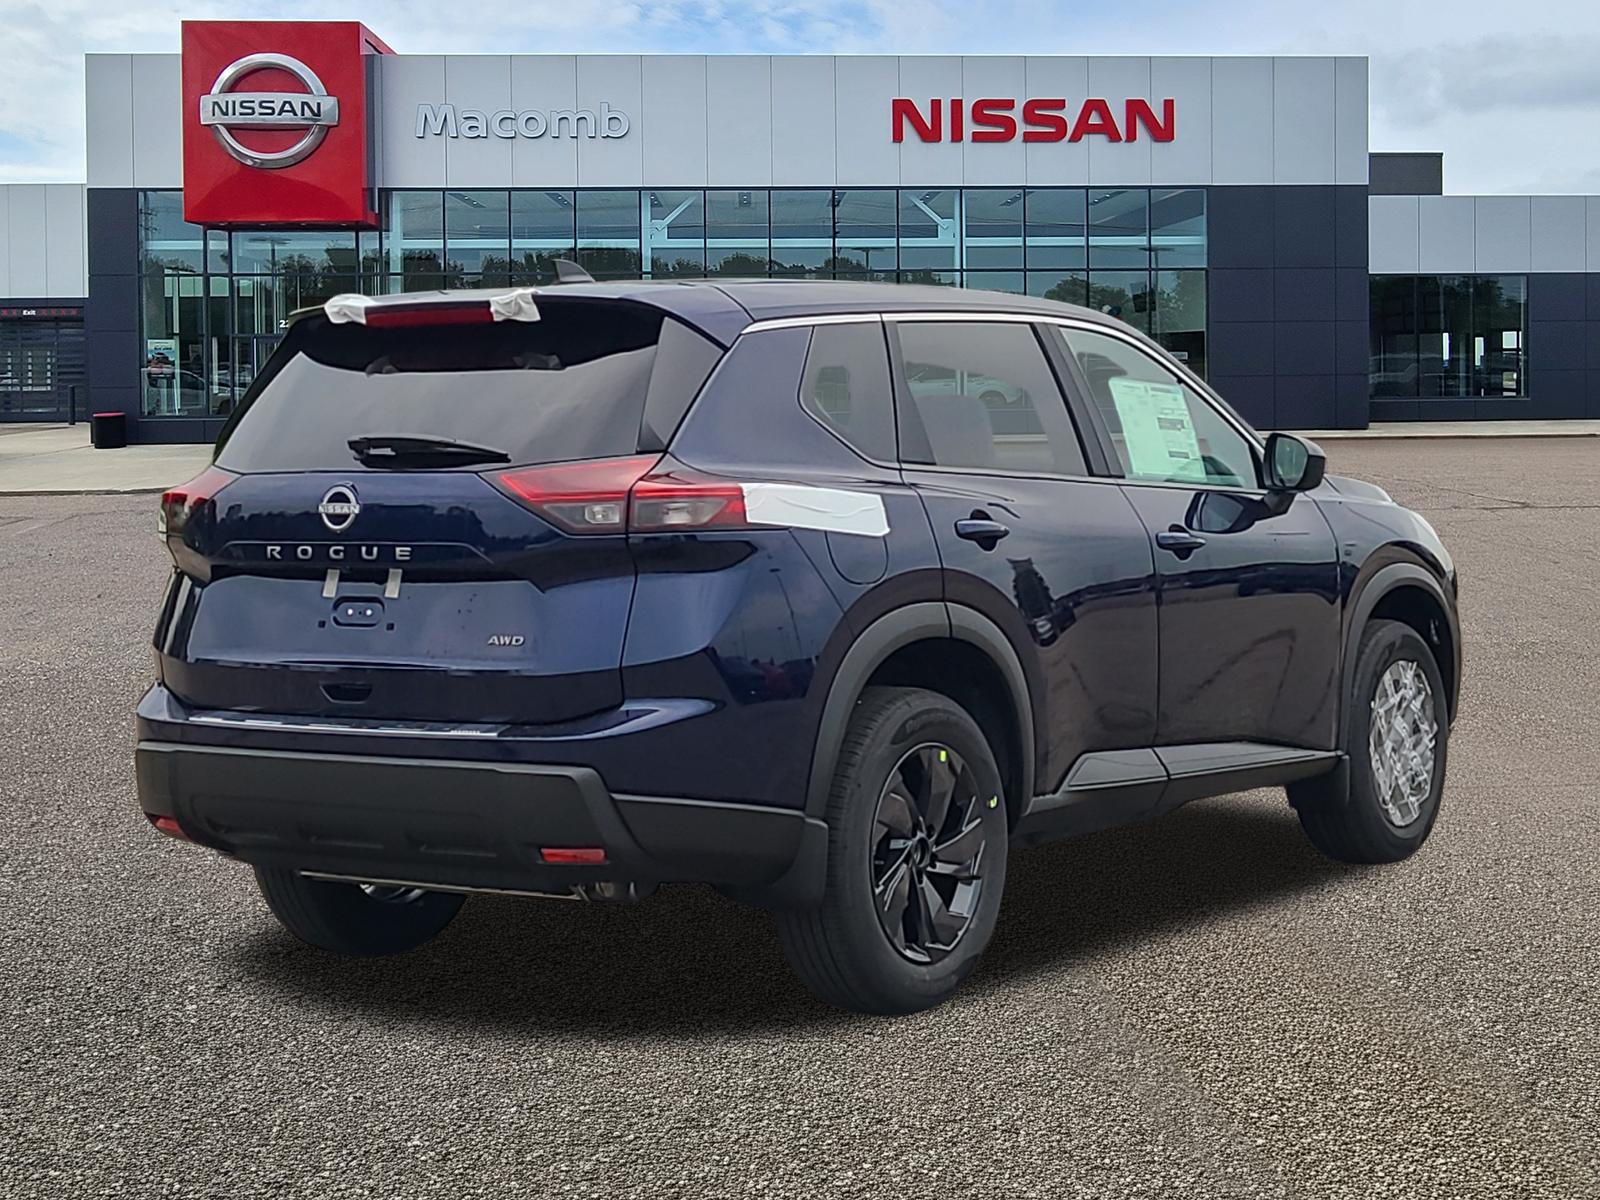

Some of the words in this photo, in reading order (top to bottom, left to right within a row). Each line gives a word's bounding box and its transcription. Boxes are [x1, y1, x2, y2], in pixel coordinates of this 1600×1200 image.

[212, 99, 321, 118] NISSAN
[415, 102, 630, 139] Macomb
[891, 98, 1175, 143] NISSAN
[318, 503, 360, 514] NISSAN
[266, 546, 412, 561] ROGUE
[487, 635, 525, 646] AWD
